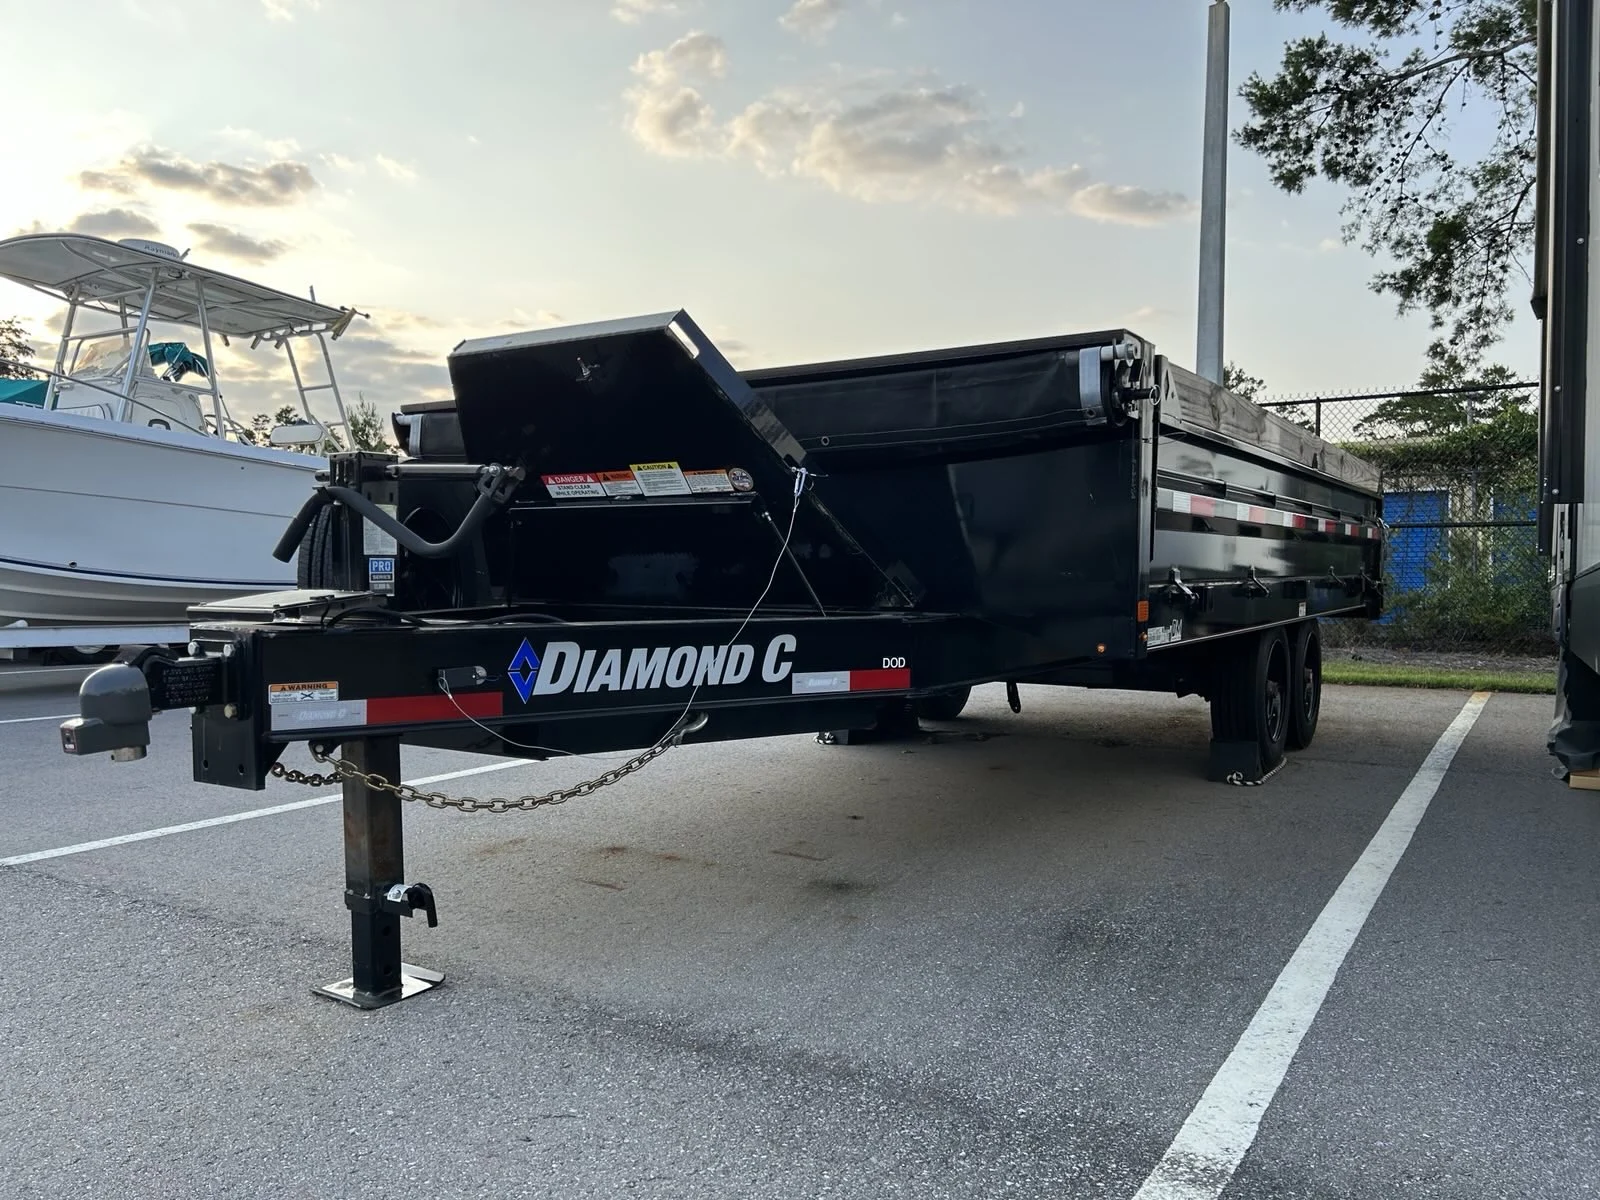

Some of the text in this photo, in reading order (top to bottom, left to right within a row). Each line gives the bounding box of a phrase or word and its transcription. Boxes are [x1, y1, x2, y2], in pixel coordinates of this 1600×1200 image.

[554, 475, 586, 484] DANGER
[372, 561, 391, 572] PRO
[531, 634, 797, 696] DIAMOND C
[882, 657, 906, 669] DOD
[288, 683, 328, 691] WARNING
